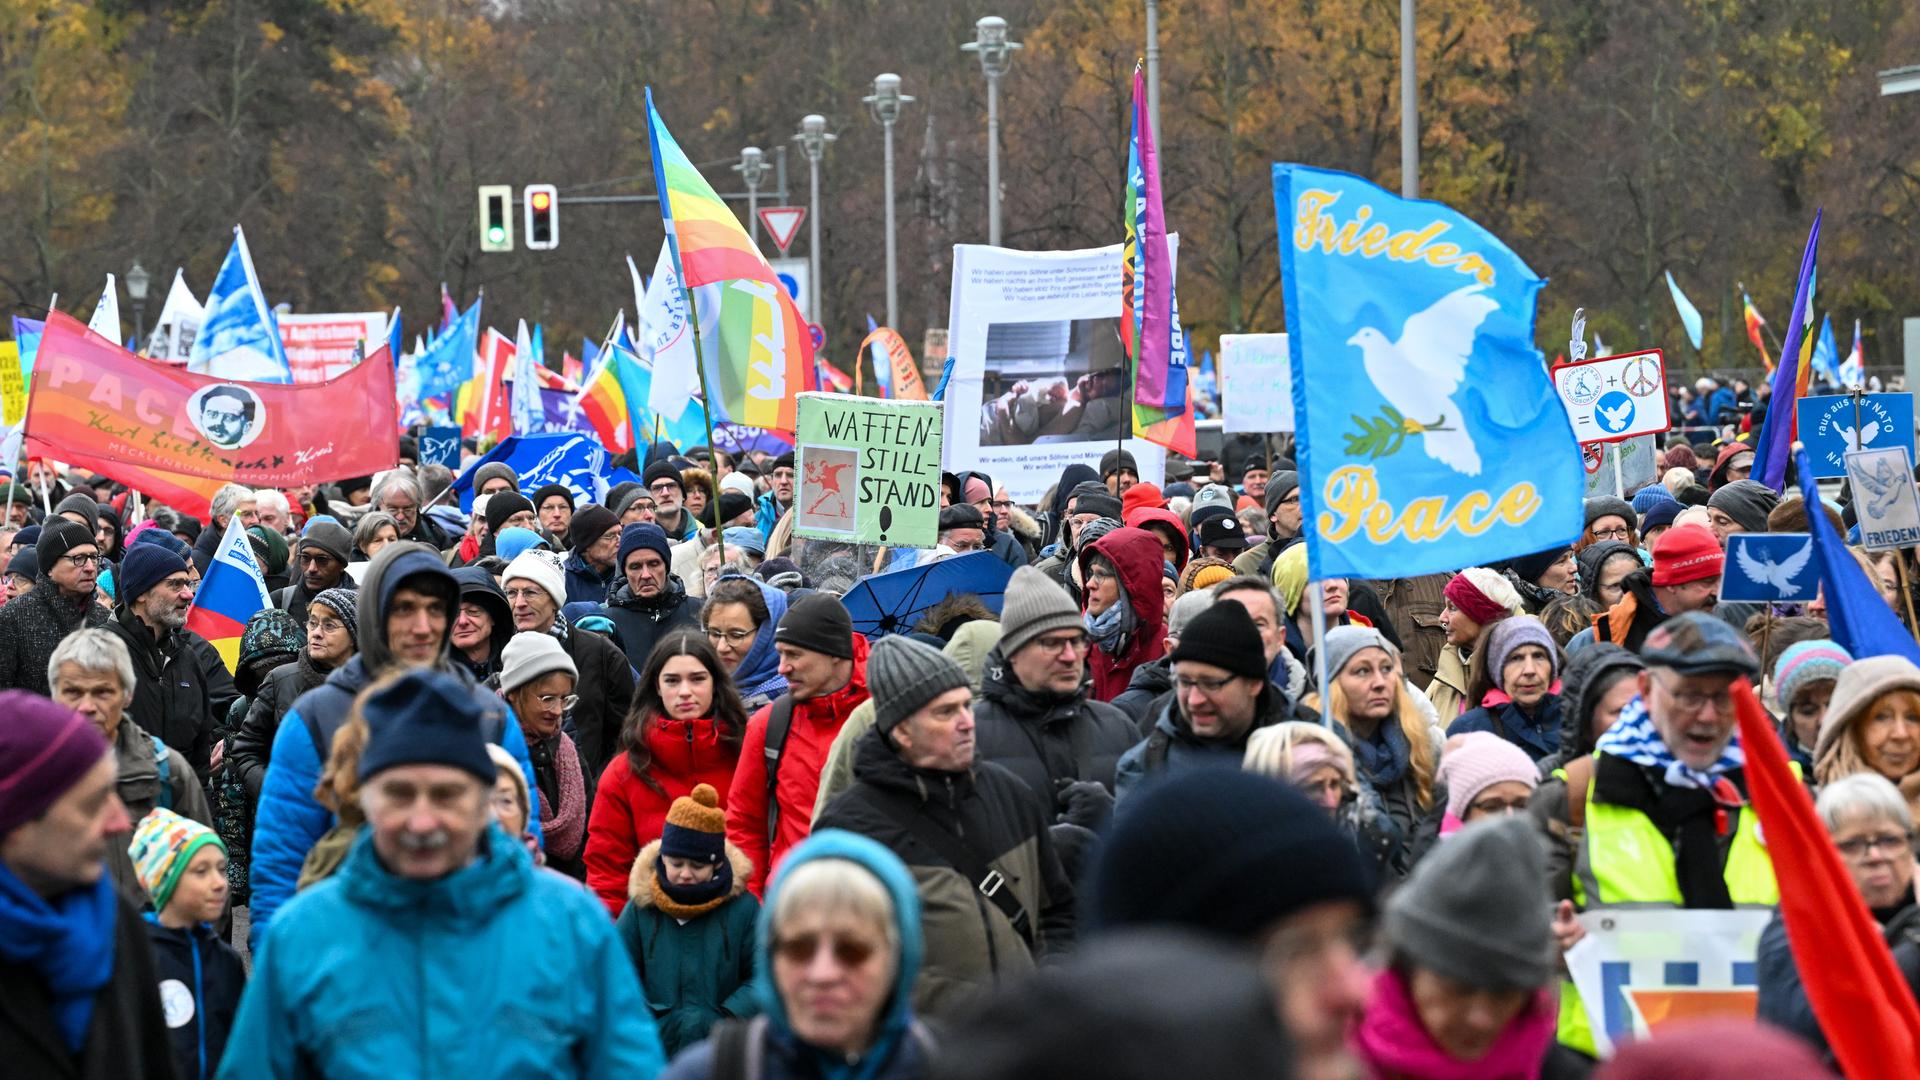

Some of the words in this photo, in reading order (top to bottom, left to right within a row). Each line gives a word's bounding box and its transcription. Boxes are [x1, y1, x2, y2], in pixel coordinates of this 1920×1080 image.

[1295, 188, 1495, 286] Frieden
[48, 356, 198, 442] PACE
[1818, 412, 1832, 436] raus
[1830, 398, 1850, 413] aus
[1872, 402, 1894, 433] NATO
[861, 447, 938, 476] STILL-
[859, 476, 935, 508] STAND
[1318, 464, 1542, 544] Peace
